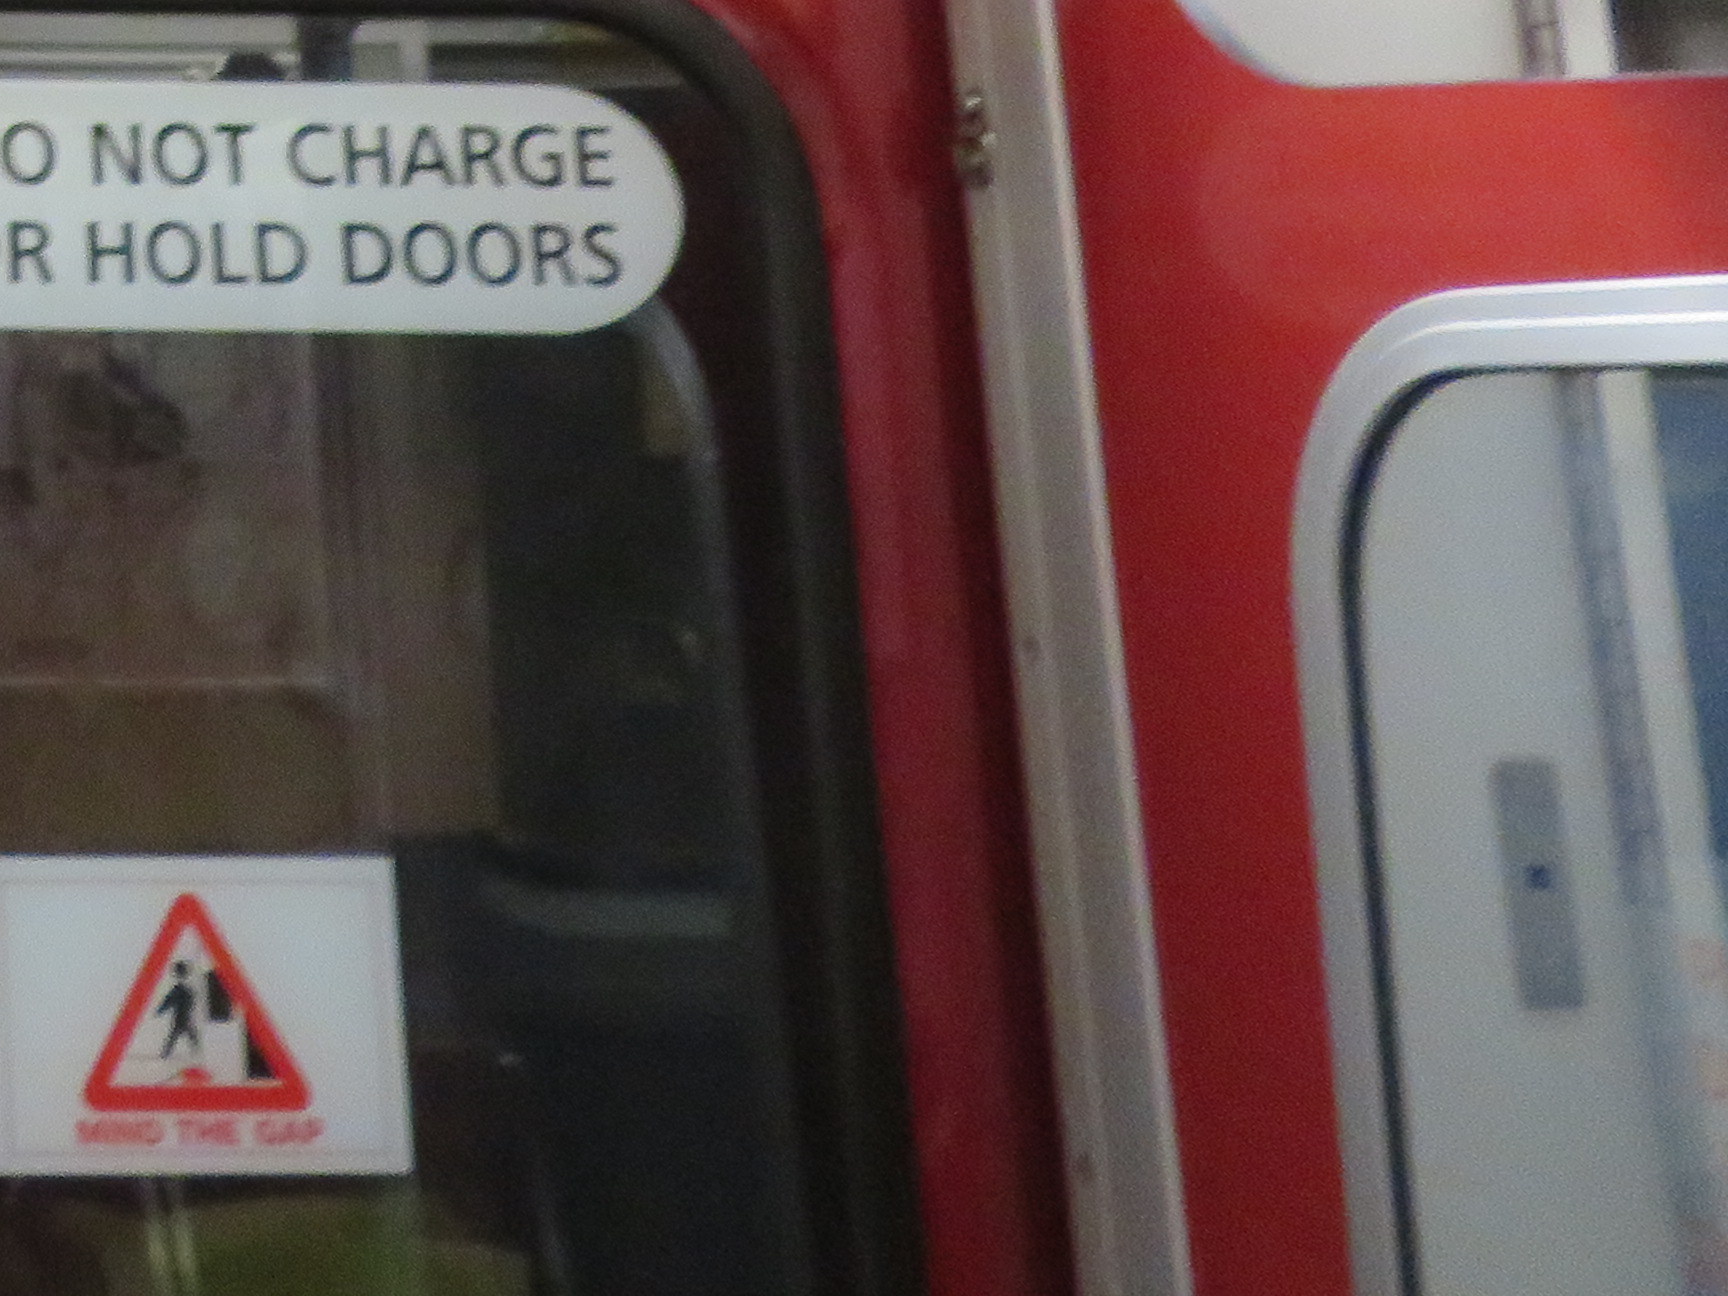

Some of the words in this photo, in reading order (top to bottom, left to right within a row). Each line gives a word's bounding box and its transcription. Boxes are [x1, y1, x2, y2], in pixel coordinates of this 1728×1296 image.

[91, 123, 257, 186] NOT
[285, 124, 616, 188] CHARGE
[85, 222, 310, 285] HOLD
[341, 223, 623, 287] DOORS
[75, 1118, 164, 1146] MIND
[176, 1117, 239, 1145] THE
[253, 1117, 326, 1146] GAP
